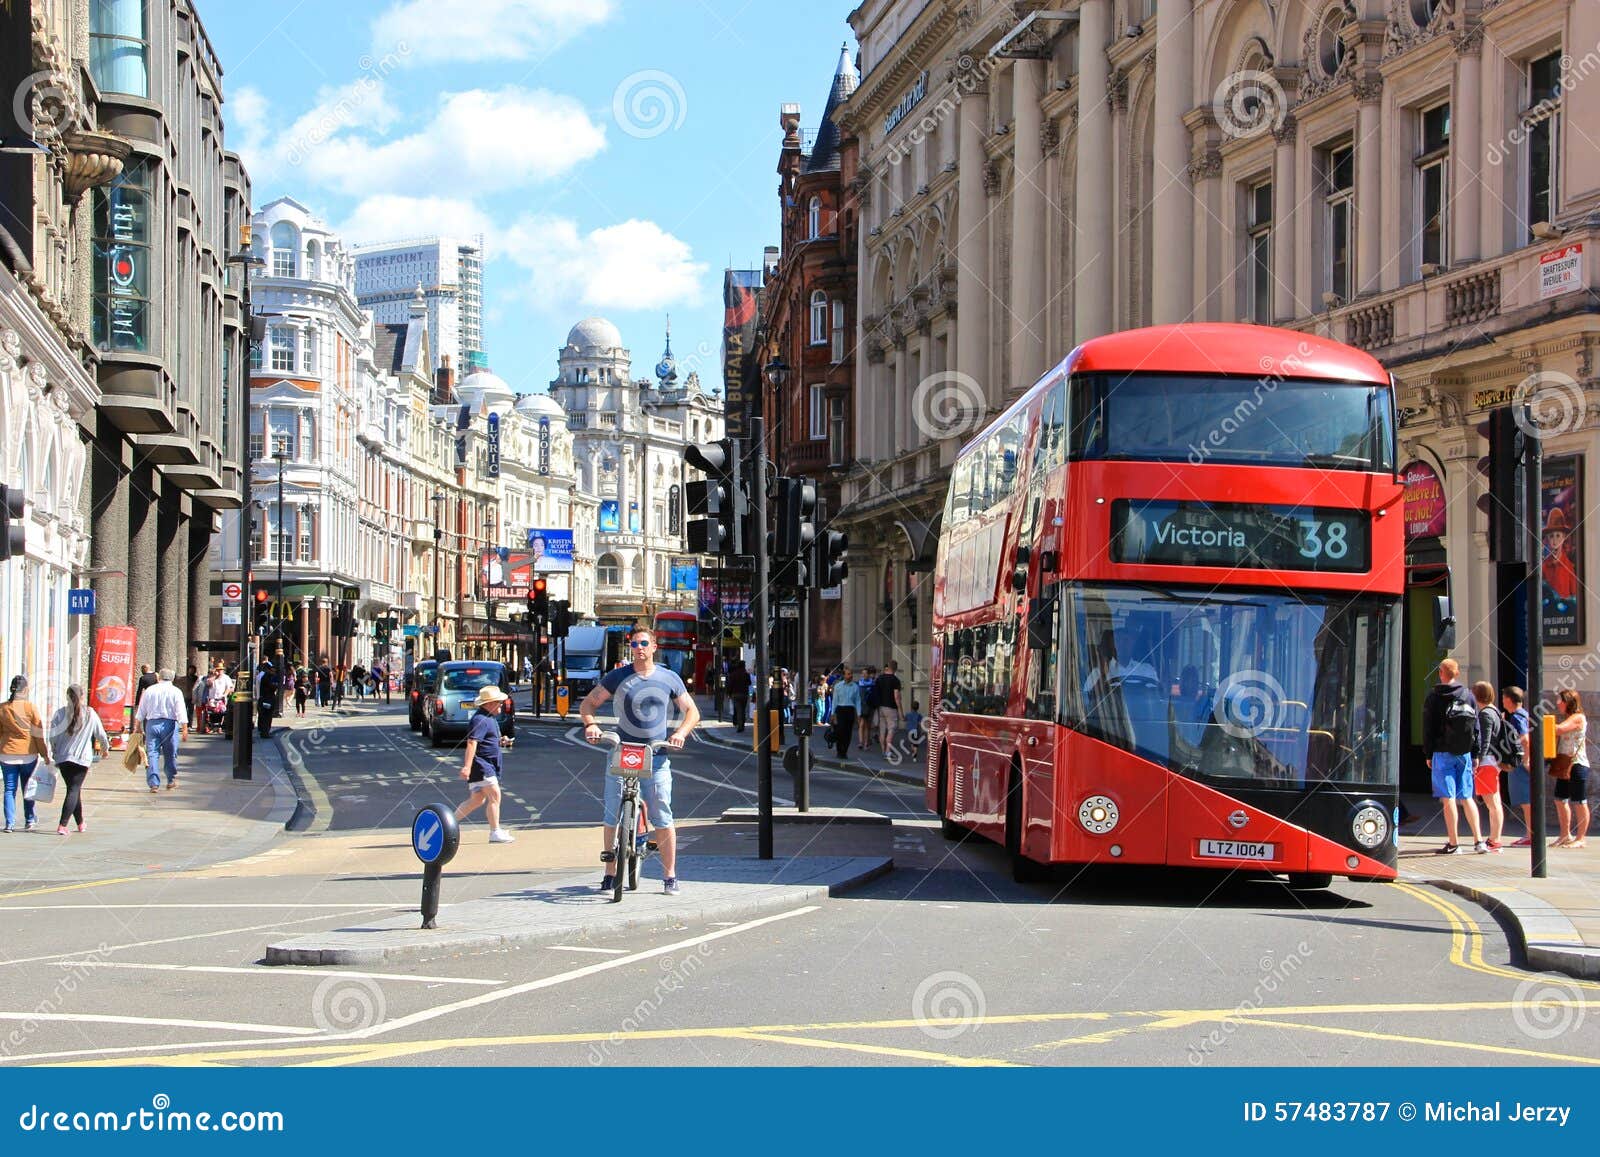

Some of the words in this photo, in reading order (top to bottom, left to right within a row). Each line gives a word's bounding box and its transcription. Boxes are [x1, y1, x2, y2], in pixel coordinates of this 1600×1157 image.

[1543, 257, 1578, 277] SHAFTESBURY
[113, 285, 135, 336] JAPAN
[727, 332, 743, 403] BUFALA
[727, 411, 742, 433] LA
[489, 423, 499, 474] LYRIC
[540, 424, 549, 474] APOLLO
[1152, 521, 1246, 548] Victoria
[1299, 521, 1349, 560] 38
[71, 595, 90, 608] GAP
[482, 587, 530, 597] THRILLER
[100, 654, 131, 665] SUSHI
[1207, 841, 1233, 855] LTZ
